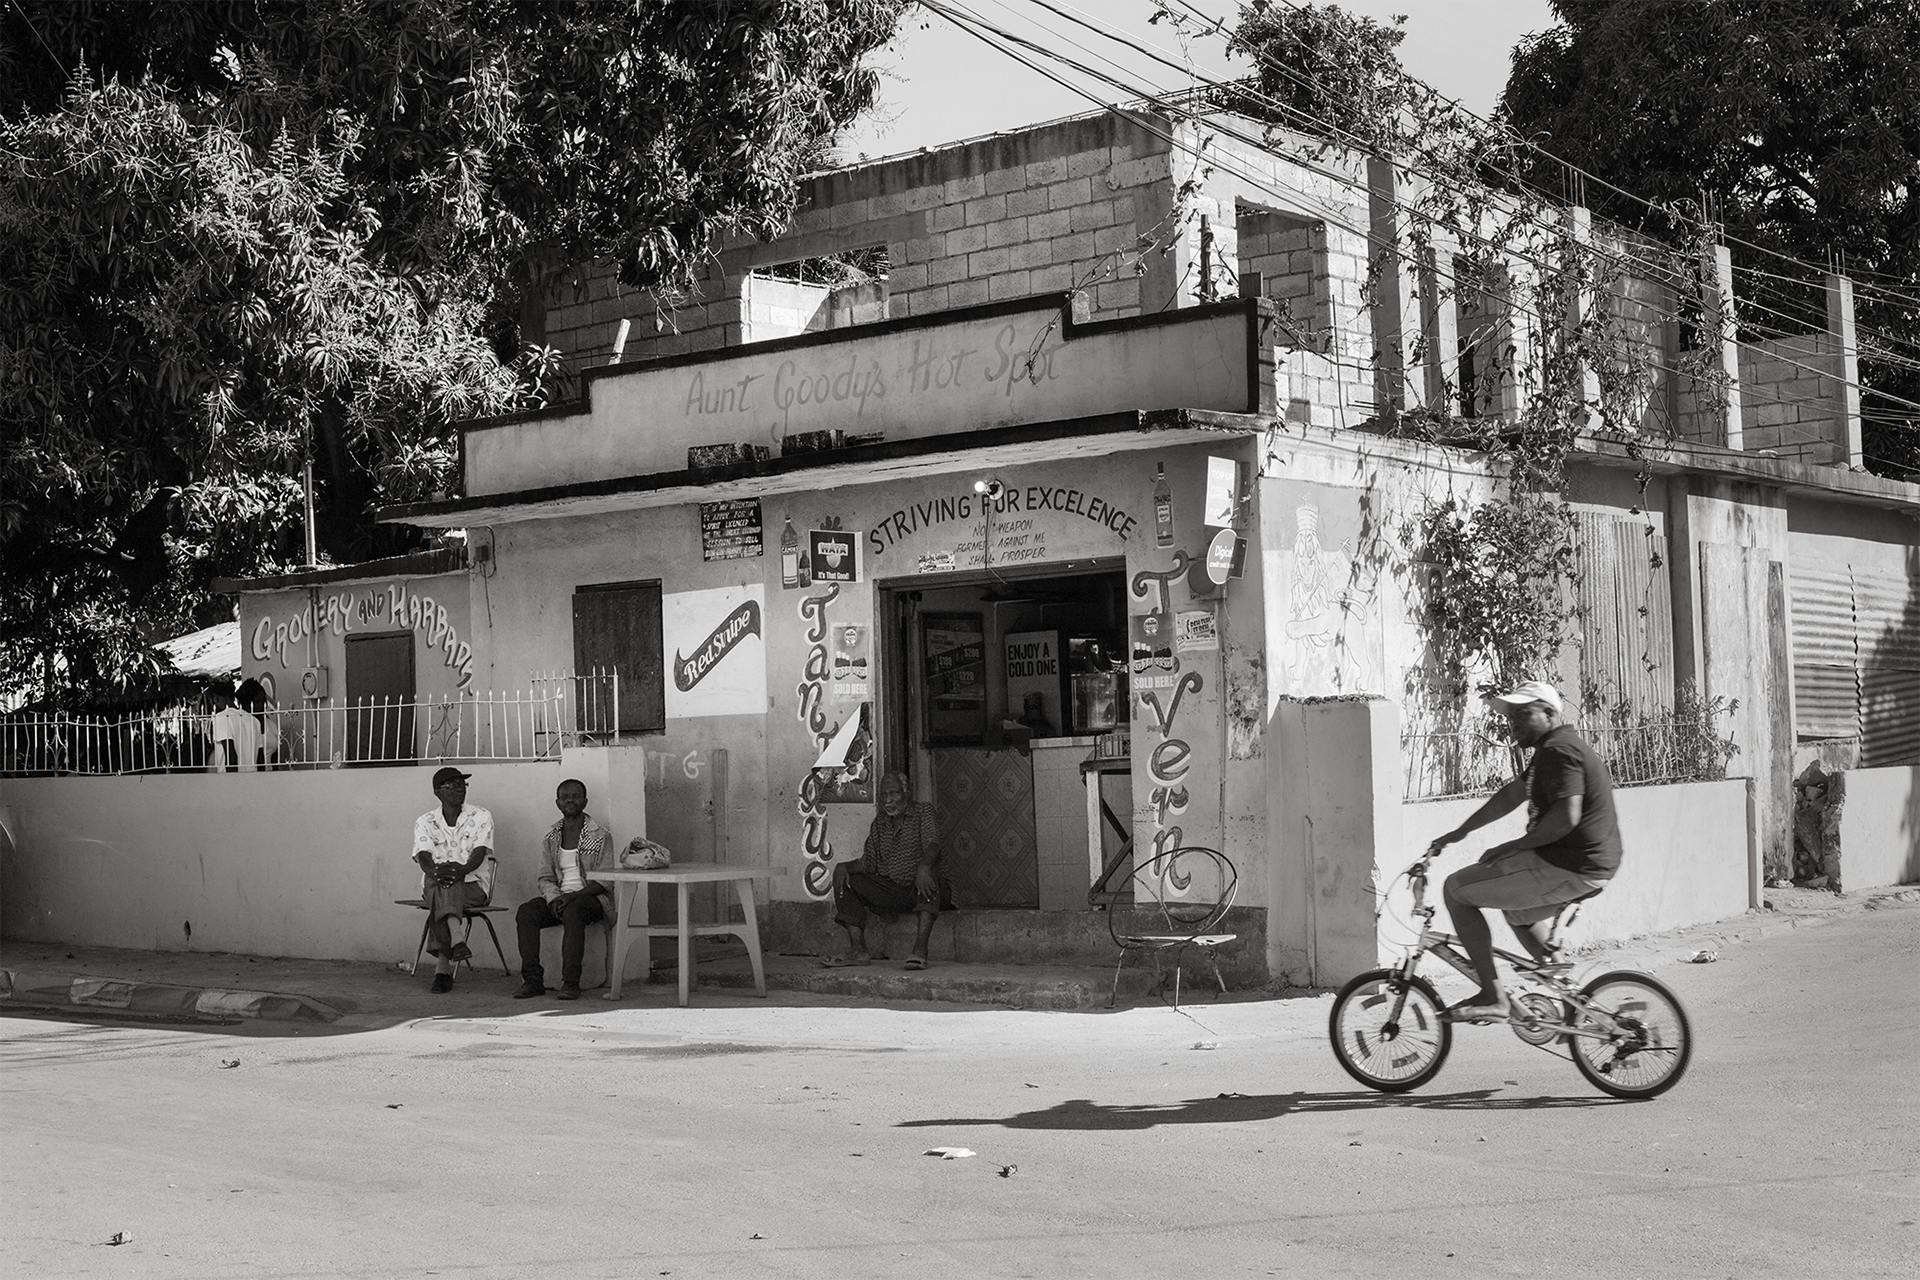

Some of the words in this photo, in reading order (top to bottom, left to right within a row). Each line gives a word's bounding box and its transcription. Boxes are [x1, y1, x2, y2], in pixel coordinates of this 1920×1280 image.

[686, 370, 765, 416] Aunt
[908, 339, 977, 393] Hot
[984, 323, 1070, 397] Spot
[869, 496, 971, 555] STRIVING
[1026, 486, 1137, 541] EXCELENCE
[998, 519, 1034, 534] WEAPON
[997, 534, 1029, 548] AGAINST
[1034, 531, 1046, 544] ME
[1000, 546, 1046, 562] PROSPER
[252, 592, 354, 668] GROCERY
[358, 588, 385, 626] AND
[683, 645, 715, 686] Red
[712, 609, 751, 659] Stripe
[1007, 643, 1040, 660] ENJOY
[1042, 642, 1050, 658] A
[1008, 660, 1034, 678] COLD
[1036, 659, 1057, 676] ONE
[1134, 676, 1154, 689] SOLD
[1154, 675, 1174, 688] HERE
